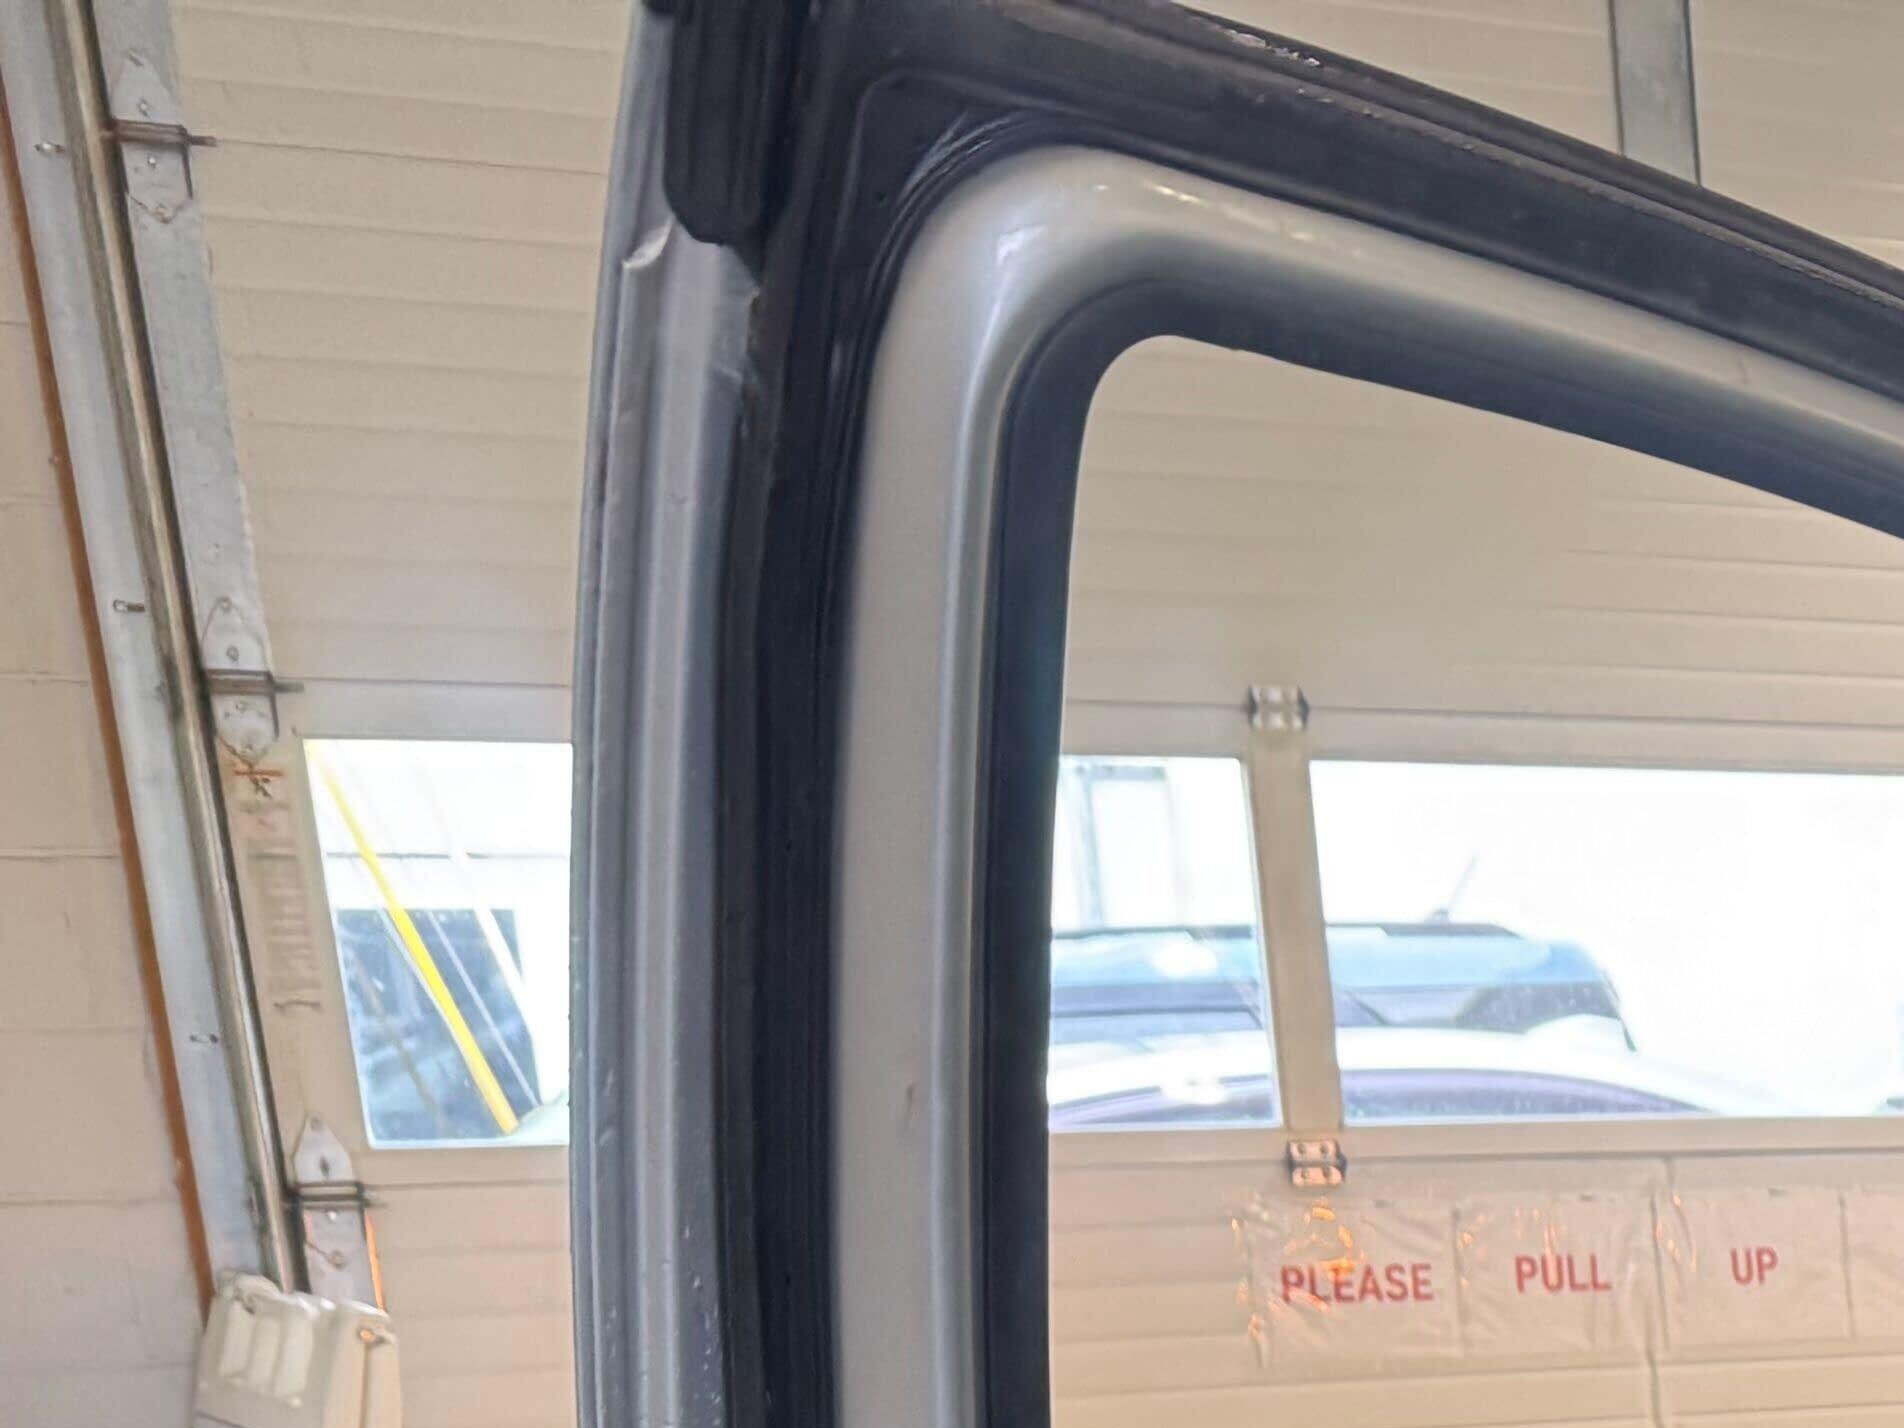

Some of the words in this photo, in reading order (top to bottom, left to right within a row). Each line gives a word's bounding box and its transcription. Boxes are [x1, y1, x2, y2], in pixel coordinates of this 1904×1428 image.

[1279, 1264, 1434, 1305] PLEASE
[1514, 1253, 1613, 1295] PULL
[1730, 1247, 1779, 1287] UP
